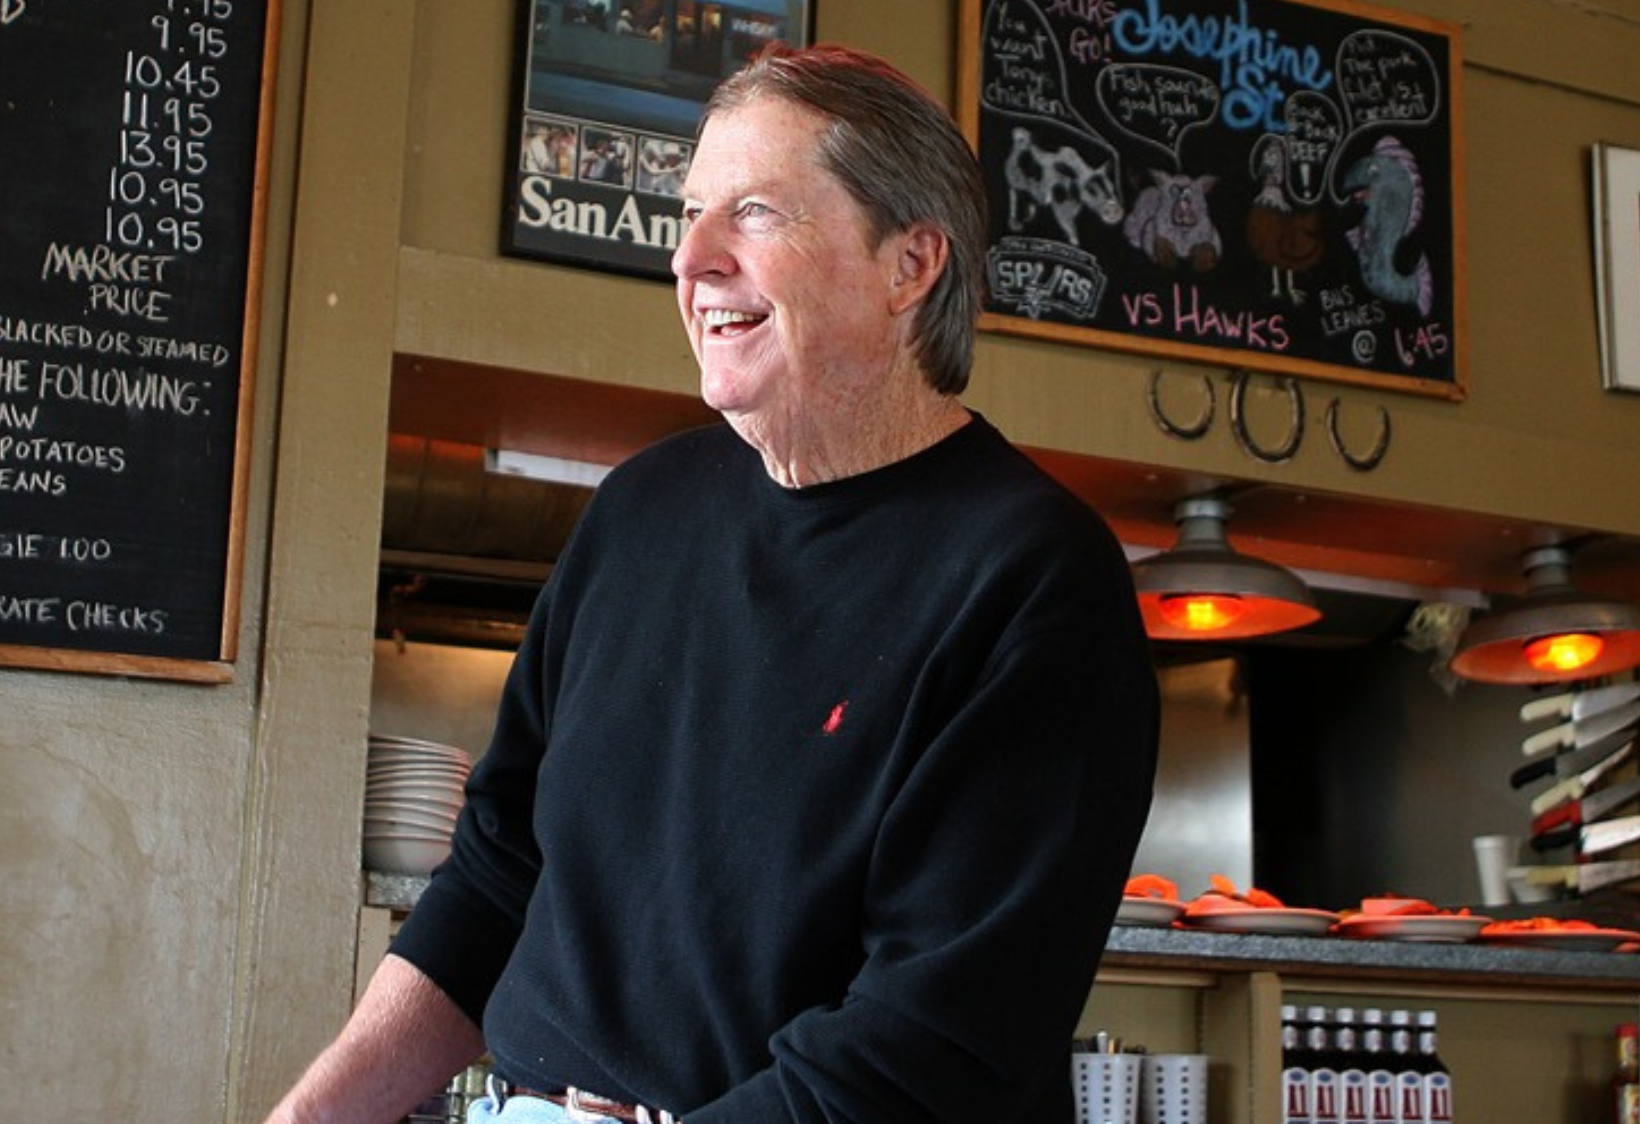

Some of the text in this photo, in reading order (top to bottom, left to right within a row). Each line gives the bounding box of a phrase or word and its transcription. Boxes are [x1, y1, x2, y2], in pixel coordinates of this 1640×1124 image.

[152, 15, 228, 58] 9.95
[1112, 0, 1333, 90] Josephine
[125, 50, 221, 99] 10.45
[123, 91, 213, 137] 11.95
[120, 129, 208, 175] 13.95
[110, 166, 205, 215] 10.95
[518, 175, 606, 238] San
[105, 206, 204, 251] 10.95
[41, 241, 177, 282] MARKET
[997, 261, 1092, 305] SPURS
[89, 283, 172, 321] PRICE
[1172, 283, 1291, 351] HAWKS
[96, 328, 131, 355] OR
[136, 333, 229, 367] STEAMED
[0, 435, 127, 472] POTATOES
